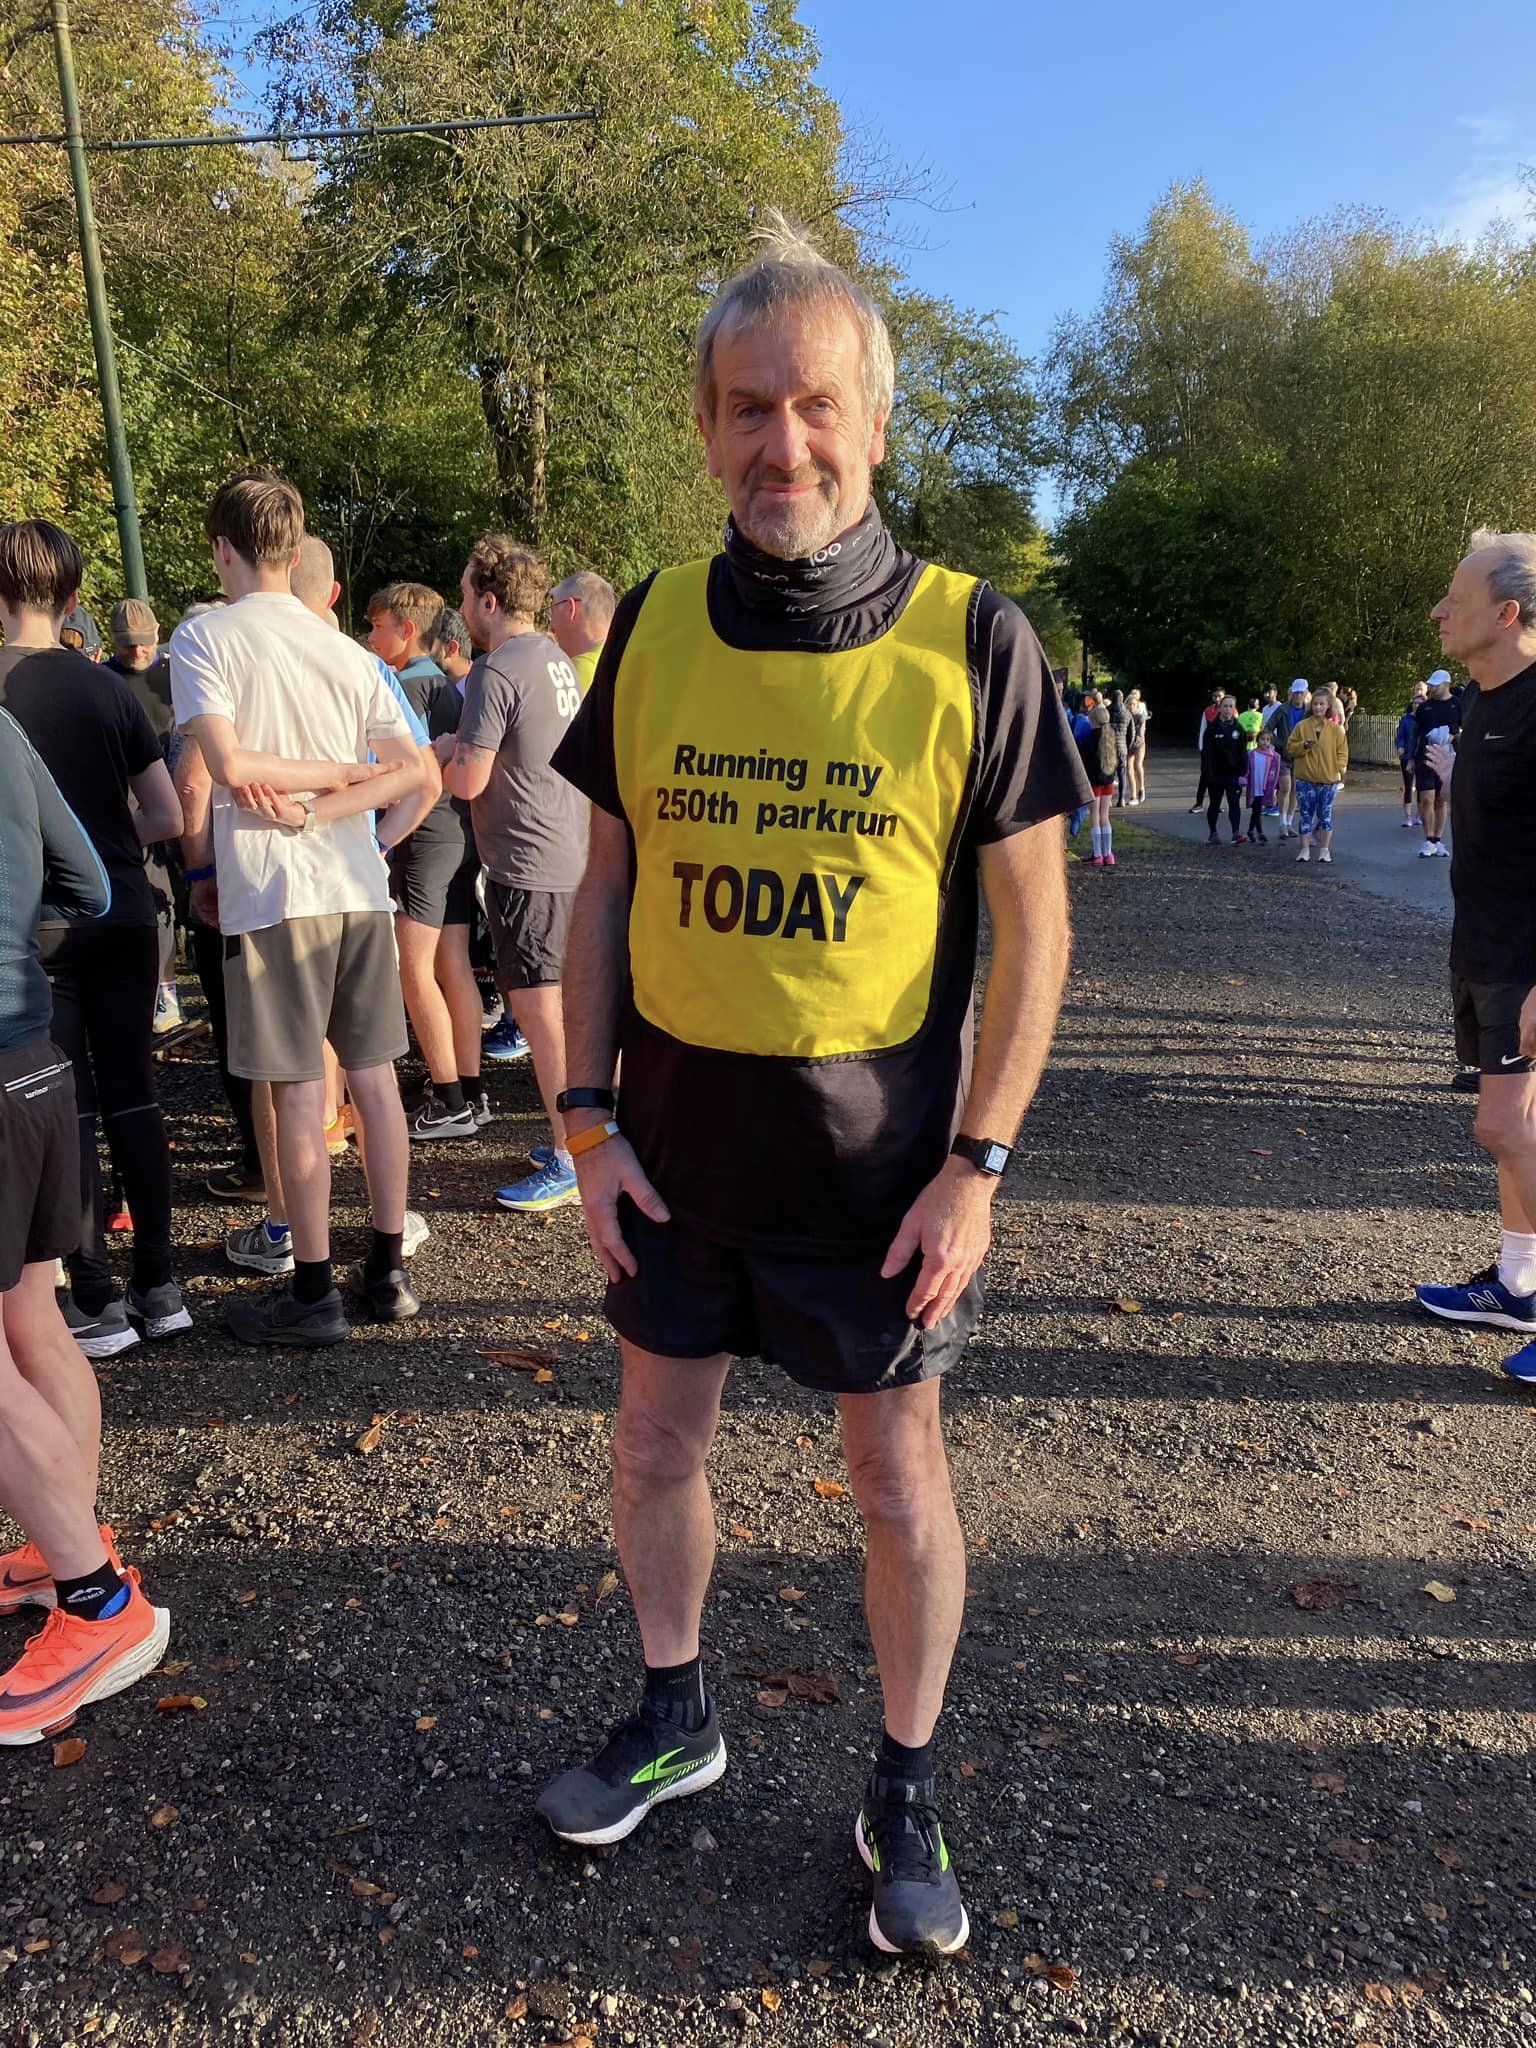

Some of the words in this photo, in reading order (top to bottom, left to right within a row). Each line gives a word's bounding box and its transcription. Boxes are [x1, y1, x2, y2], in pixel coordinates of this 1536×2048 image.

[547, 661, 576, 689] CO
[673, 744, 808, 792] Running
[825, 760, 883, 798] my
[657, 787, 738, 825] 250th
[755, 799, 898, 837] parkrun
[672, 861, 866, 943] TODAY
